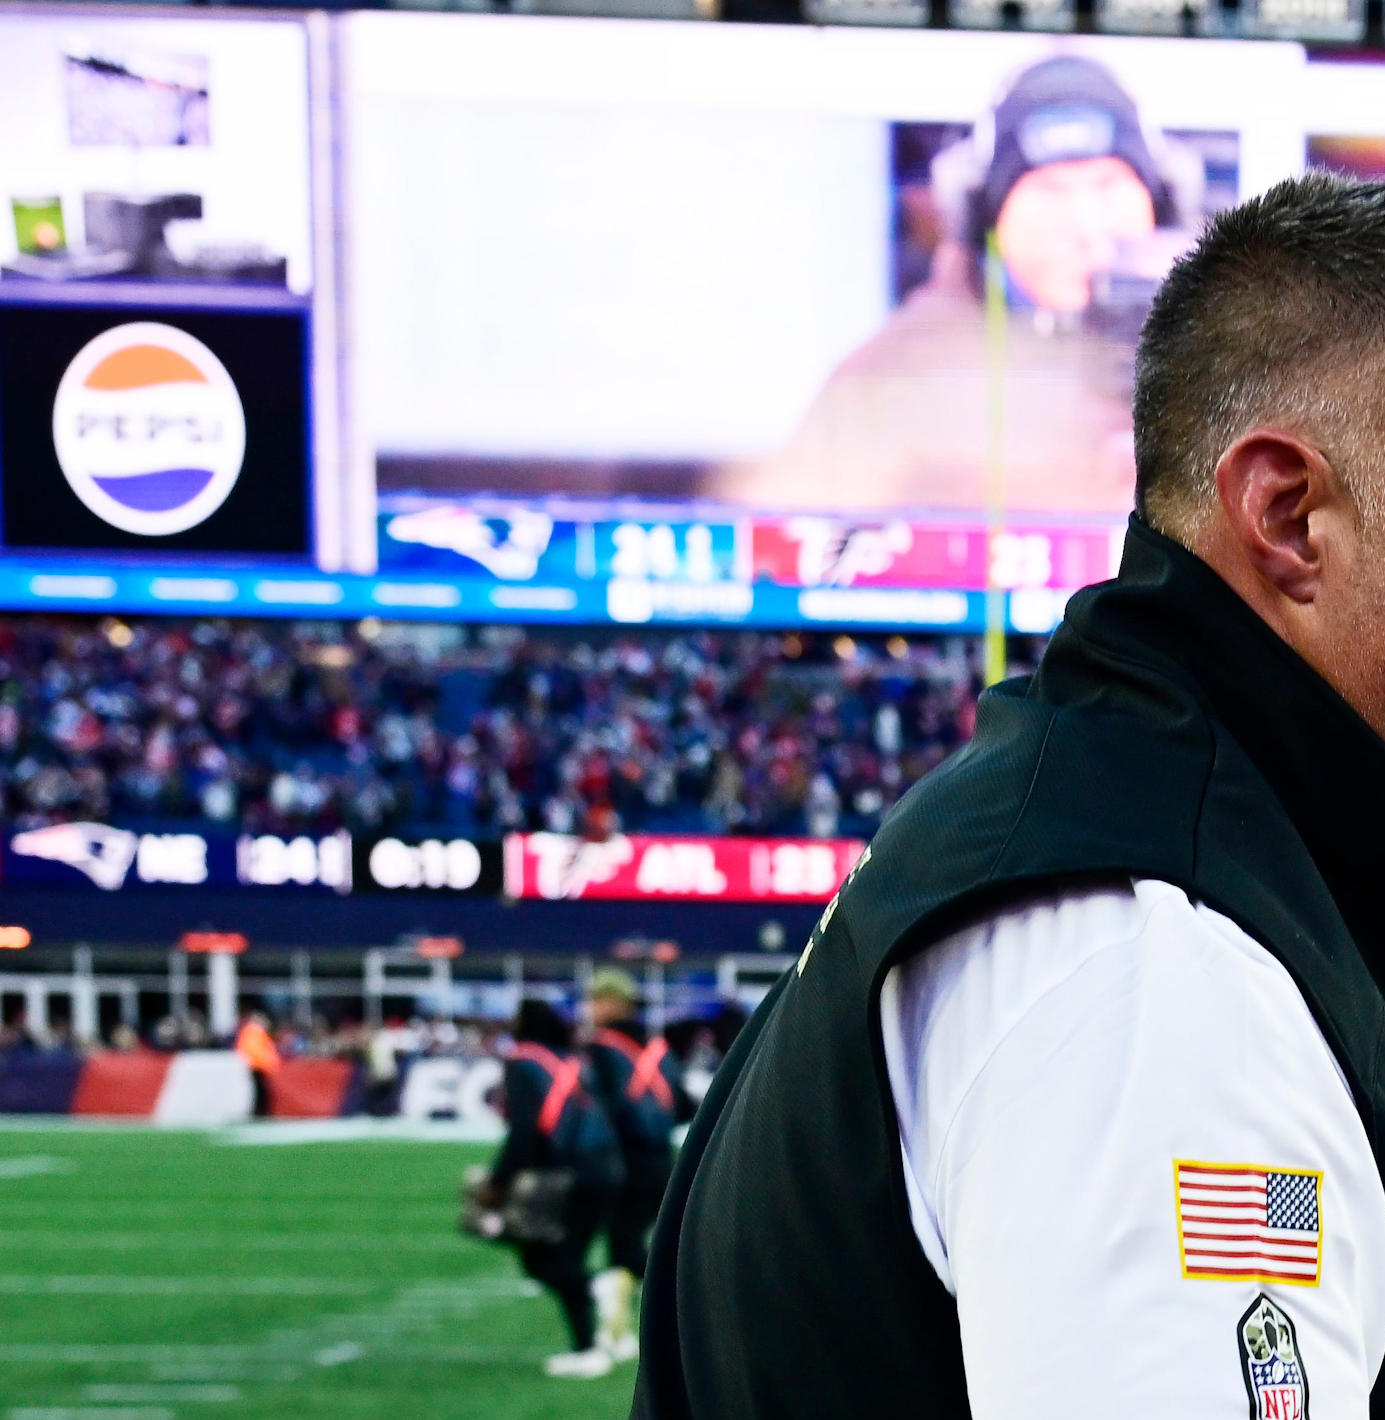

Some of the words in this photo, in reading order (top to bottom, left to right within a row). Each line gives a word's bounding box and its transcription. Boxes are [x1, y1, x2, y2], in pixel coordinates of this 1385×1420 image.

[77, 411, 223, 444] PEPSI
[137, 834, 207, 883] NE
[637, 843, 727, 895] ATL
